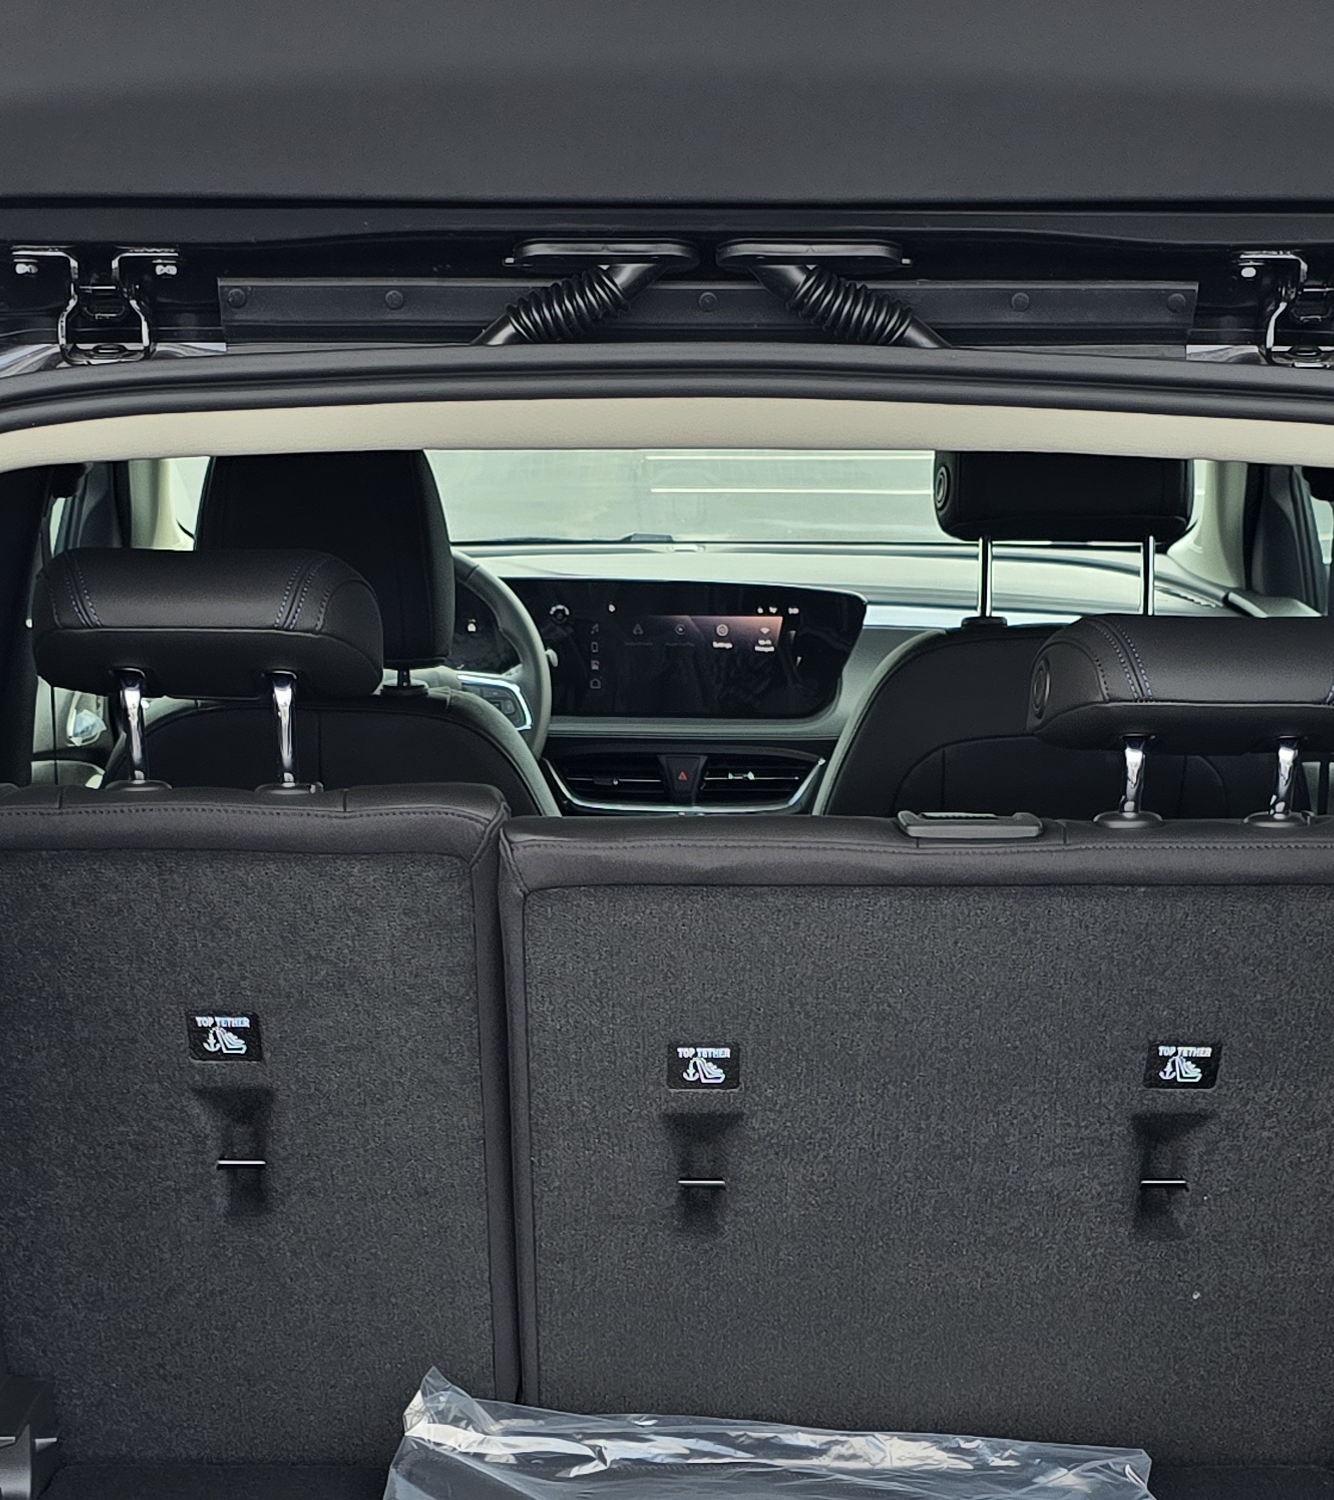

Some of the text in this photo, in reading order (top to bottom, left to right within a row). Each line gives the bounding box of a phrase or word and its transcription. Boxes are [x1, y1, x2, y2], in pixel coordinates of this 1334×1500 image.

[195, 1016, 251, 1028] TOP TETHER
[677, 1047, 731, 1059] TOP TETHER
[1157, 1046, 1212, 1058] TOP TETHER
